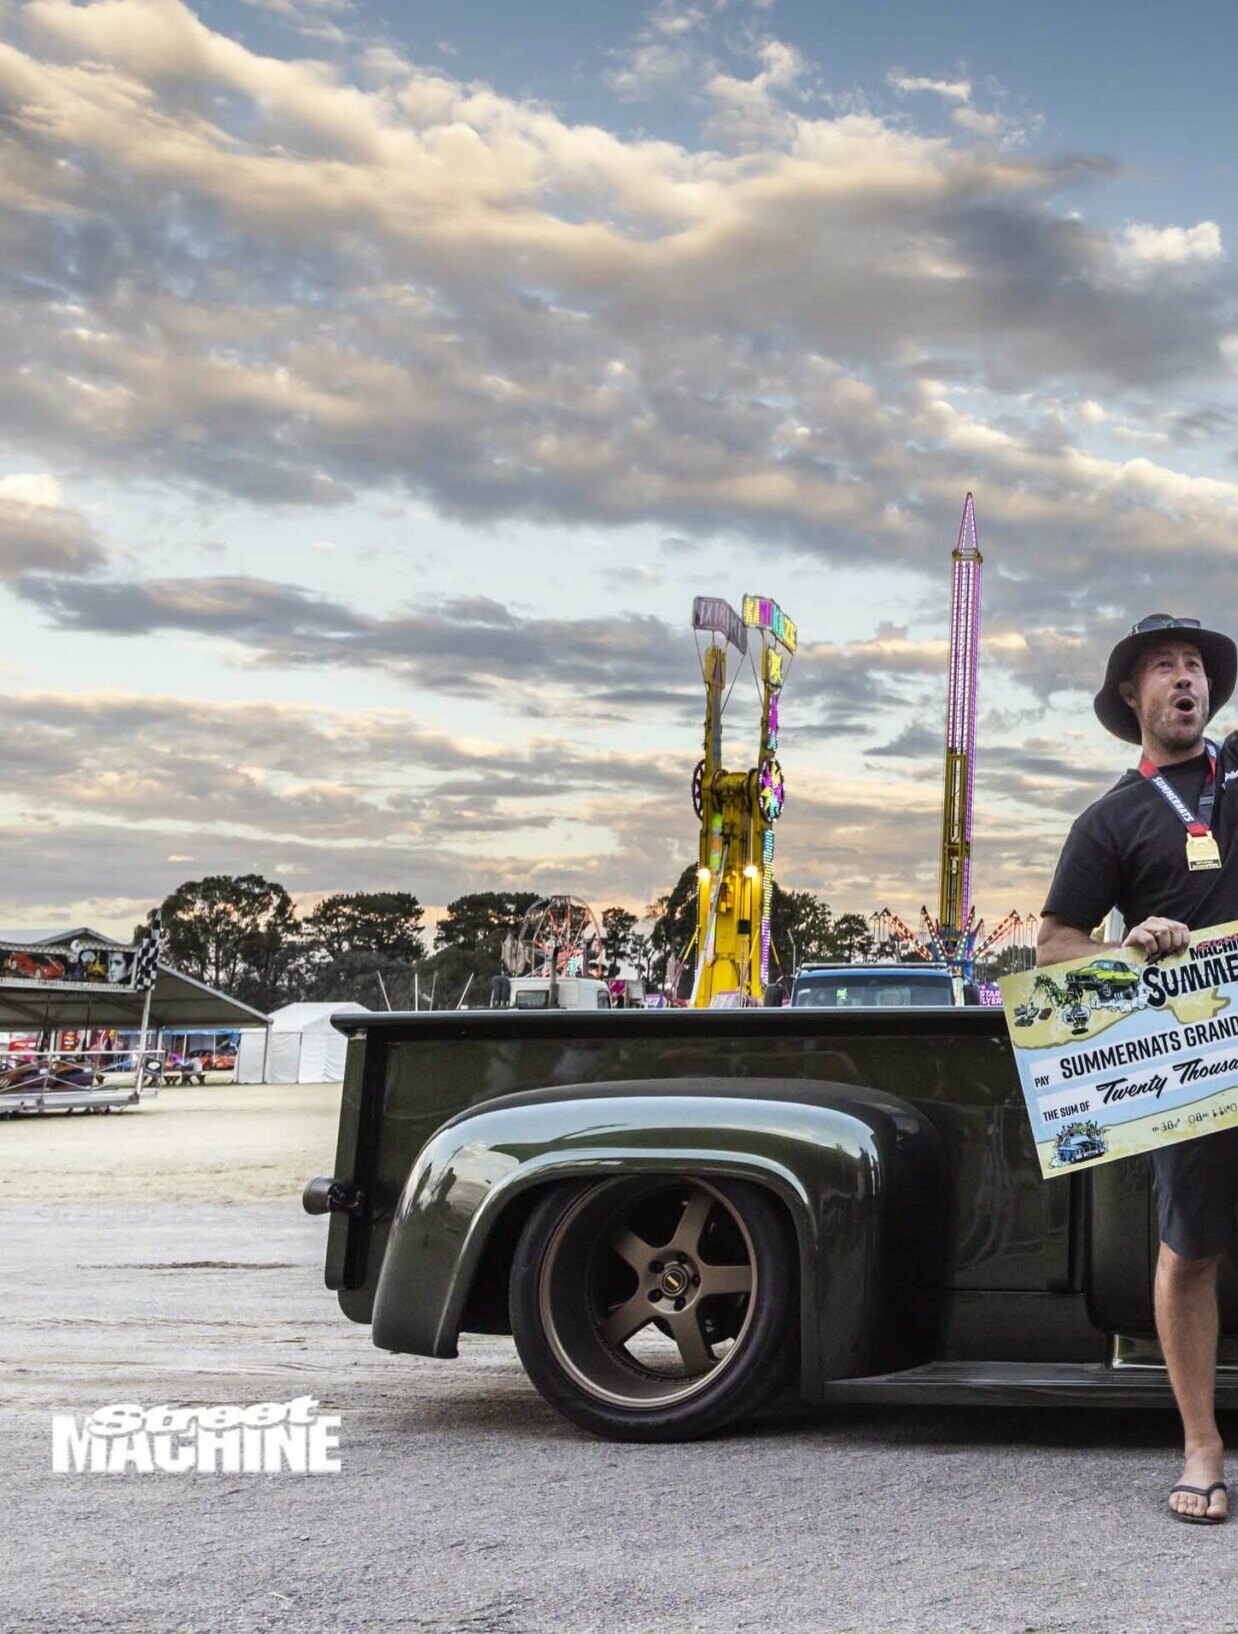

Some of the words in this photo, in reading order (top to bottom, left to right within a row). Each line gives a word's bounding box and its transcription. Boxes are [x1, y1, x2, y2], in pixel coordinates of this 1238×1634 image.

[1151, 776, 1195, 822] SUMMERNATS
[1034, 1075, 1050, 1088] PAY
[1059, 1030, 1182, 1079] SUMMERNATS
[1042, 1109, 1059, 1122] THE
[1060, 1105, 1079, 1118] SUM
[1080, 1101, 1091, 1113] OF
[1096, 1076, 1168, 1105] Twenty
